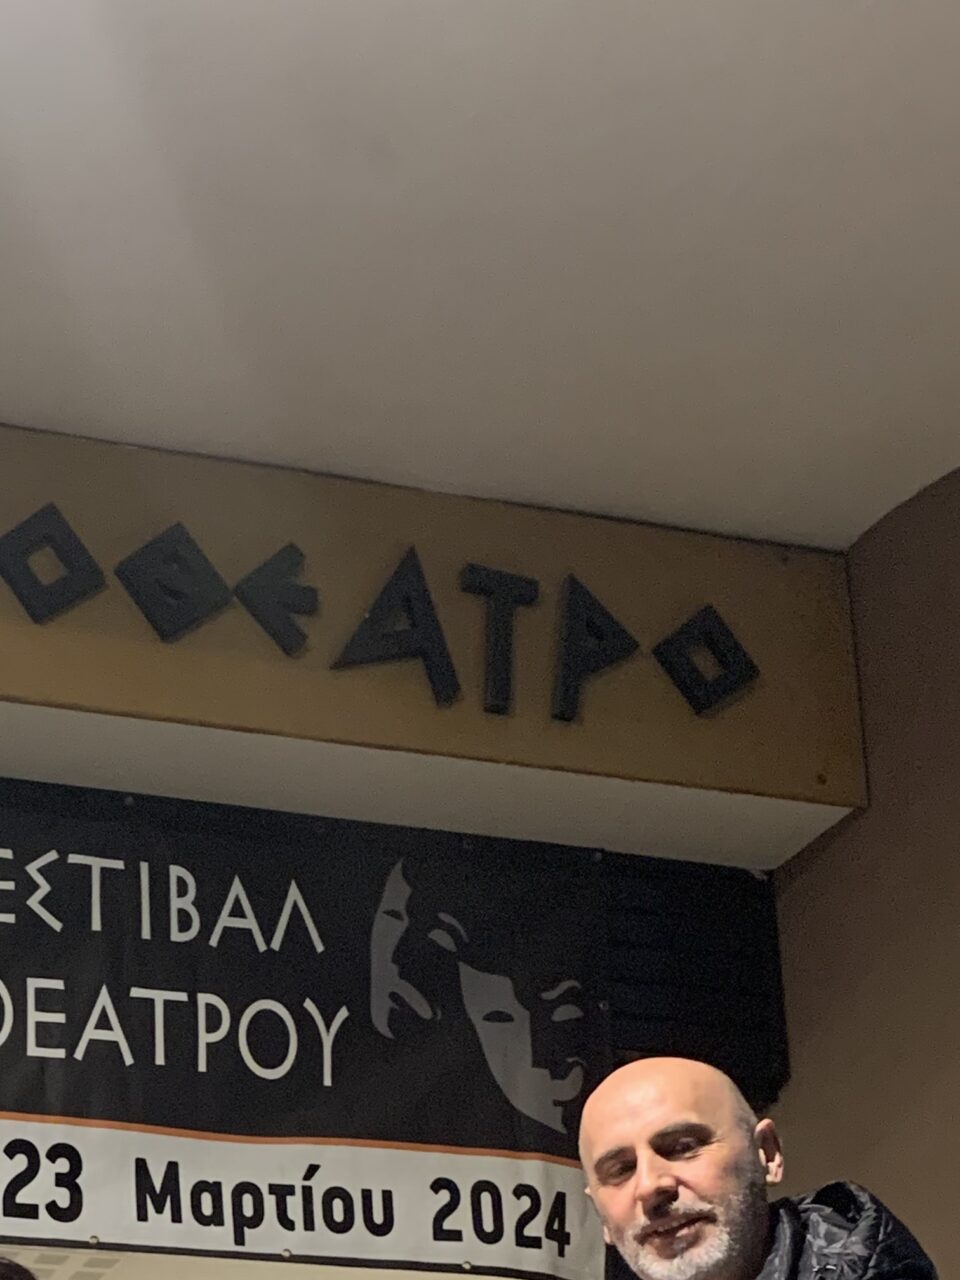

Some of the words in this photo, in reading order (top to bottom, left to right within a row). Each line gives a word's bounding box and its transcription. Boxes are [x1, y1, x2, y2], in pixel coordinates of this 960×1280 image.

[2, 1139, 84, 1222] 23
[135, 1157, 395, 1246] Μαρτίου
[430, 1177, 571, 1257] 2024
